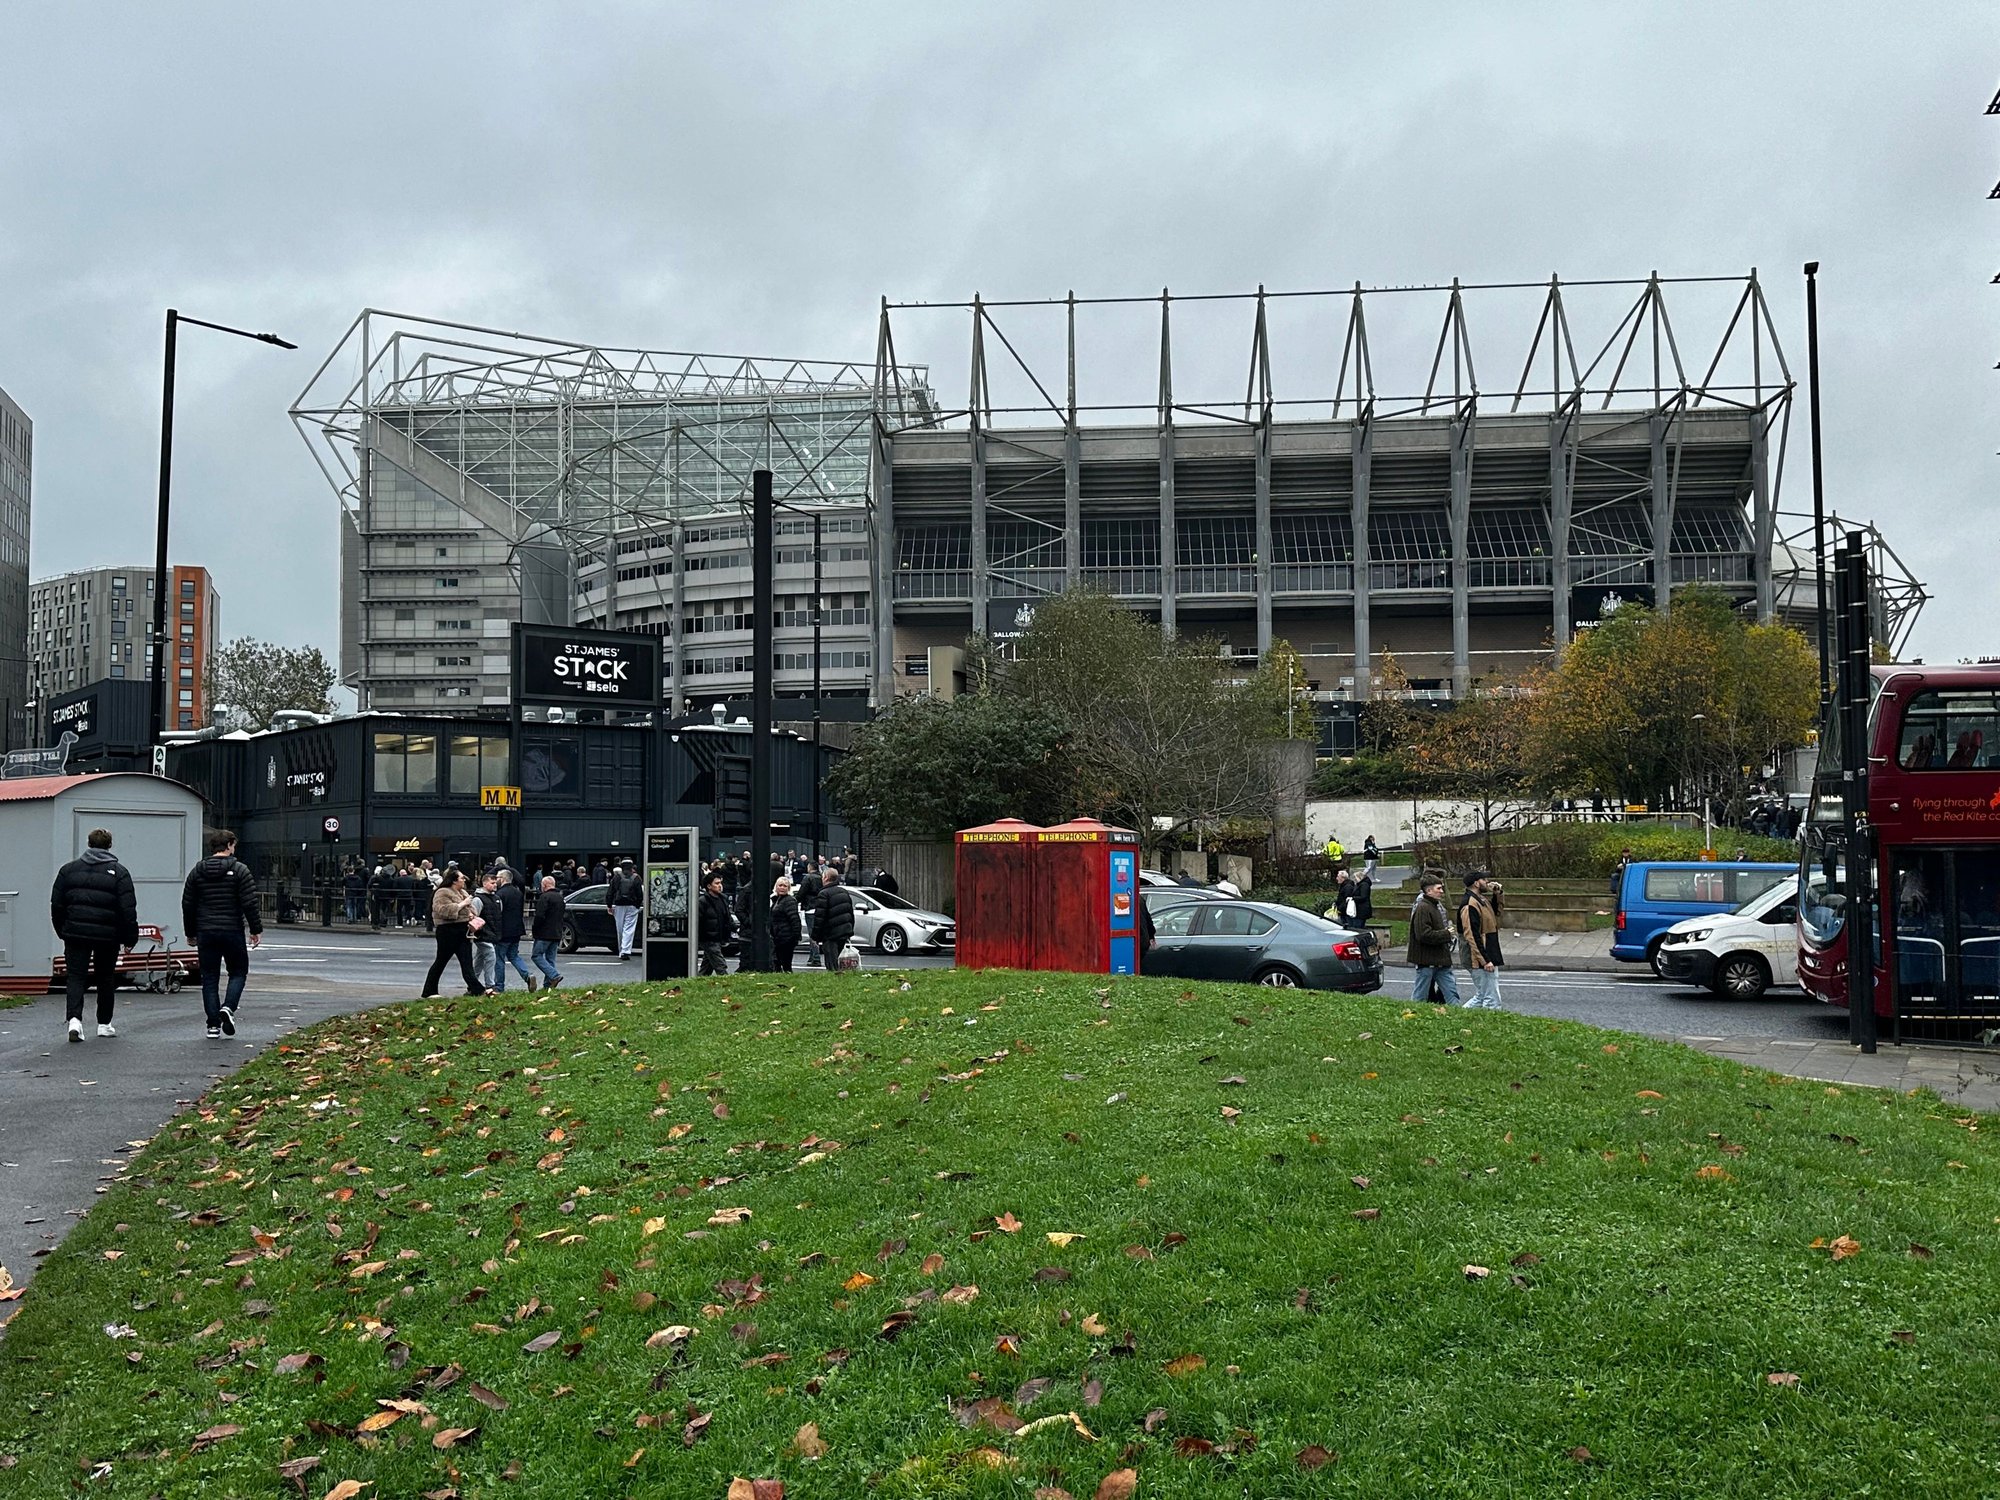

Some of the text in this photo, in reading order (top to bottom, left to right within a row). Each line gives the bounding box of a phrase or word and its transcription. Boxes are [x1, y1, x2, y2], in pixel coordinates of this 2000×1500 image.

[565, 644, 620, 657] ST.JAMES'
[596, 681, 619, 693] sela
[485, 790, 517, 805] M M
[1913, 797, 1986, 810] flying through
[1923, 812, 1941, 821] the
[1944, 811, 1964, 821] Red
[1966, 811, 1987, 820] Kite
[326, 821, 338, 829] 30
[967, 834, 1016, 842] TELEPHONE
[1043, 833, 1094, 841] TELEPHONE
[393, 836, 420, 852] yolo
